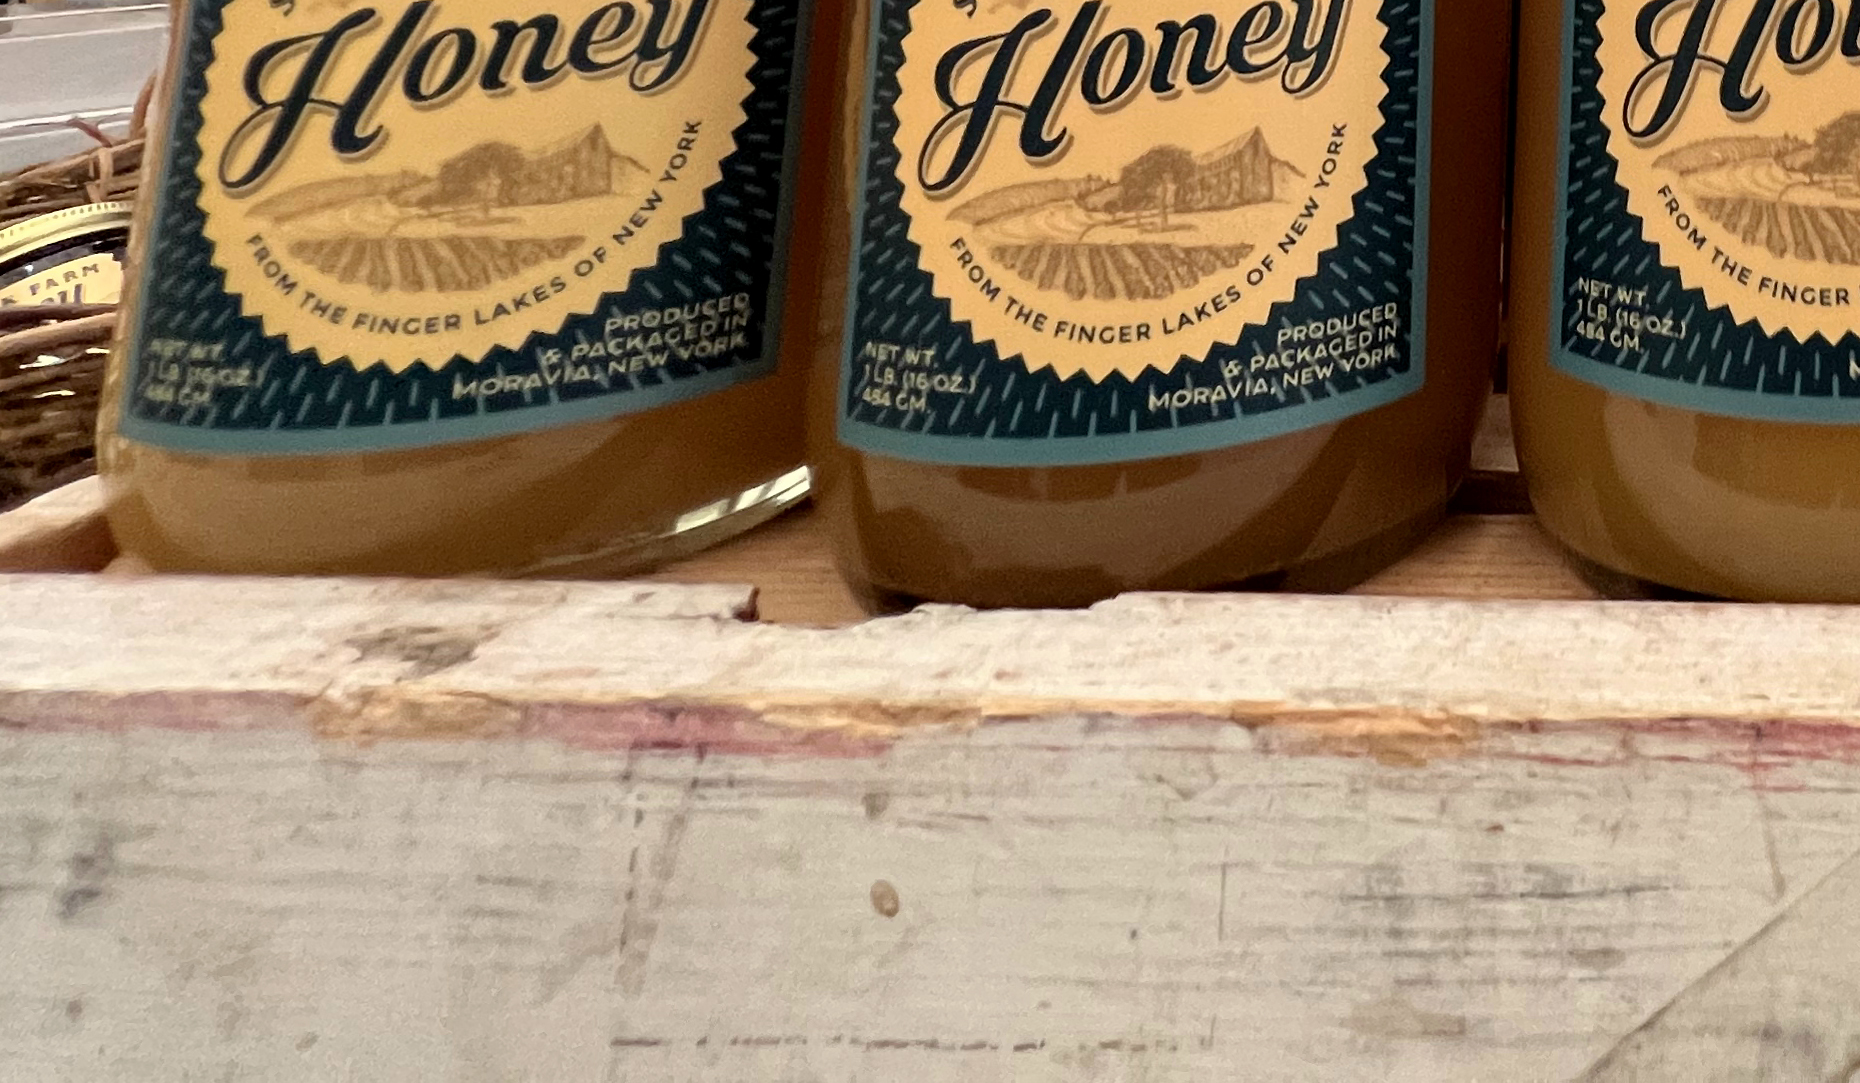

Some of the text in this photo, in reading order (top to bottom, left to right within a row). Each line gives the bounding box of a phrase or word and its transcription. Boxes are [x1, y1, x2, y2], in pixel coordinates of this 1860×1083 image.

[247, 119, 702, 335] FROM THE FINGER LAKES OF NEW YORK
[950, 122, 1347, 345] FROM THE FINGER LAKES OF NEW YORK
[1657, 184, 1708, 250] FROM
[1711, 245, 1752, 286] THE
[1758, 276, 1849, 306] FINGER
[1578, 276, 1612, 299] NET
[605, 293, 750, 334] PRODUCED
[1277, 302, 1397, 346] PRODUCED
[571, 321, 717, 358] PACKAGED
[608, 350, 668, 375] NEW
[680, 333, 748, 360] YORK
[865, 342, 899, 362] NET
[1223, 323, 1397, 378] & PACKAGED IN
[1148, 343, 1398, 412] MORAVIA, NEW YORK
